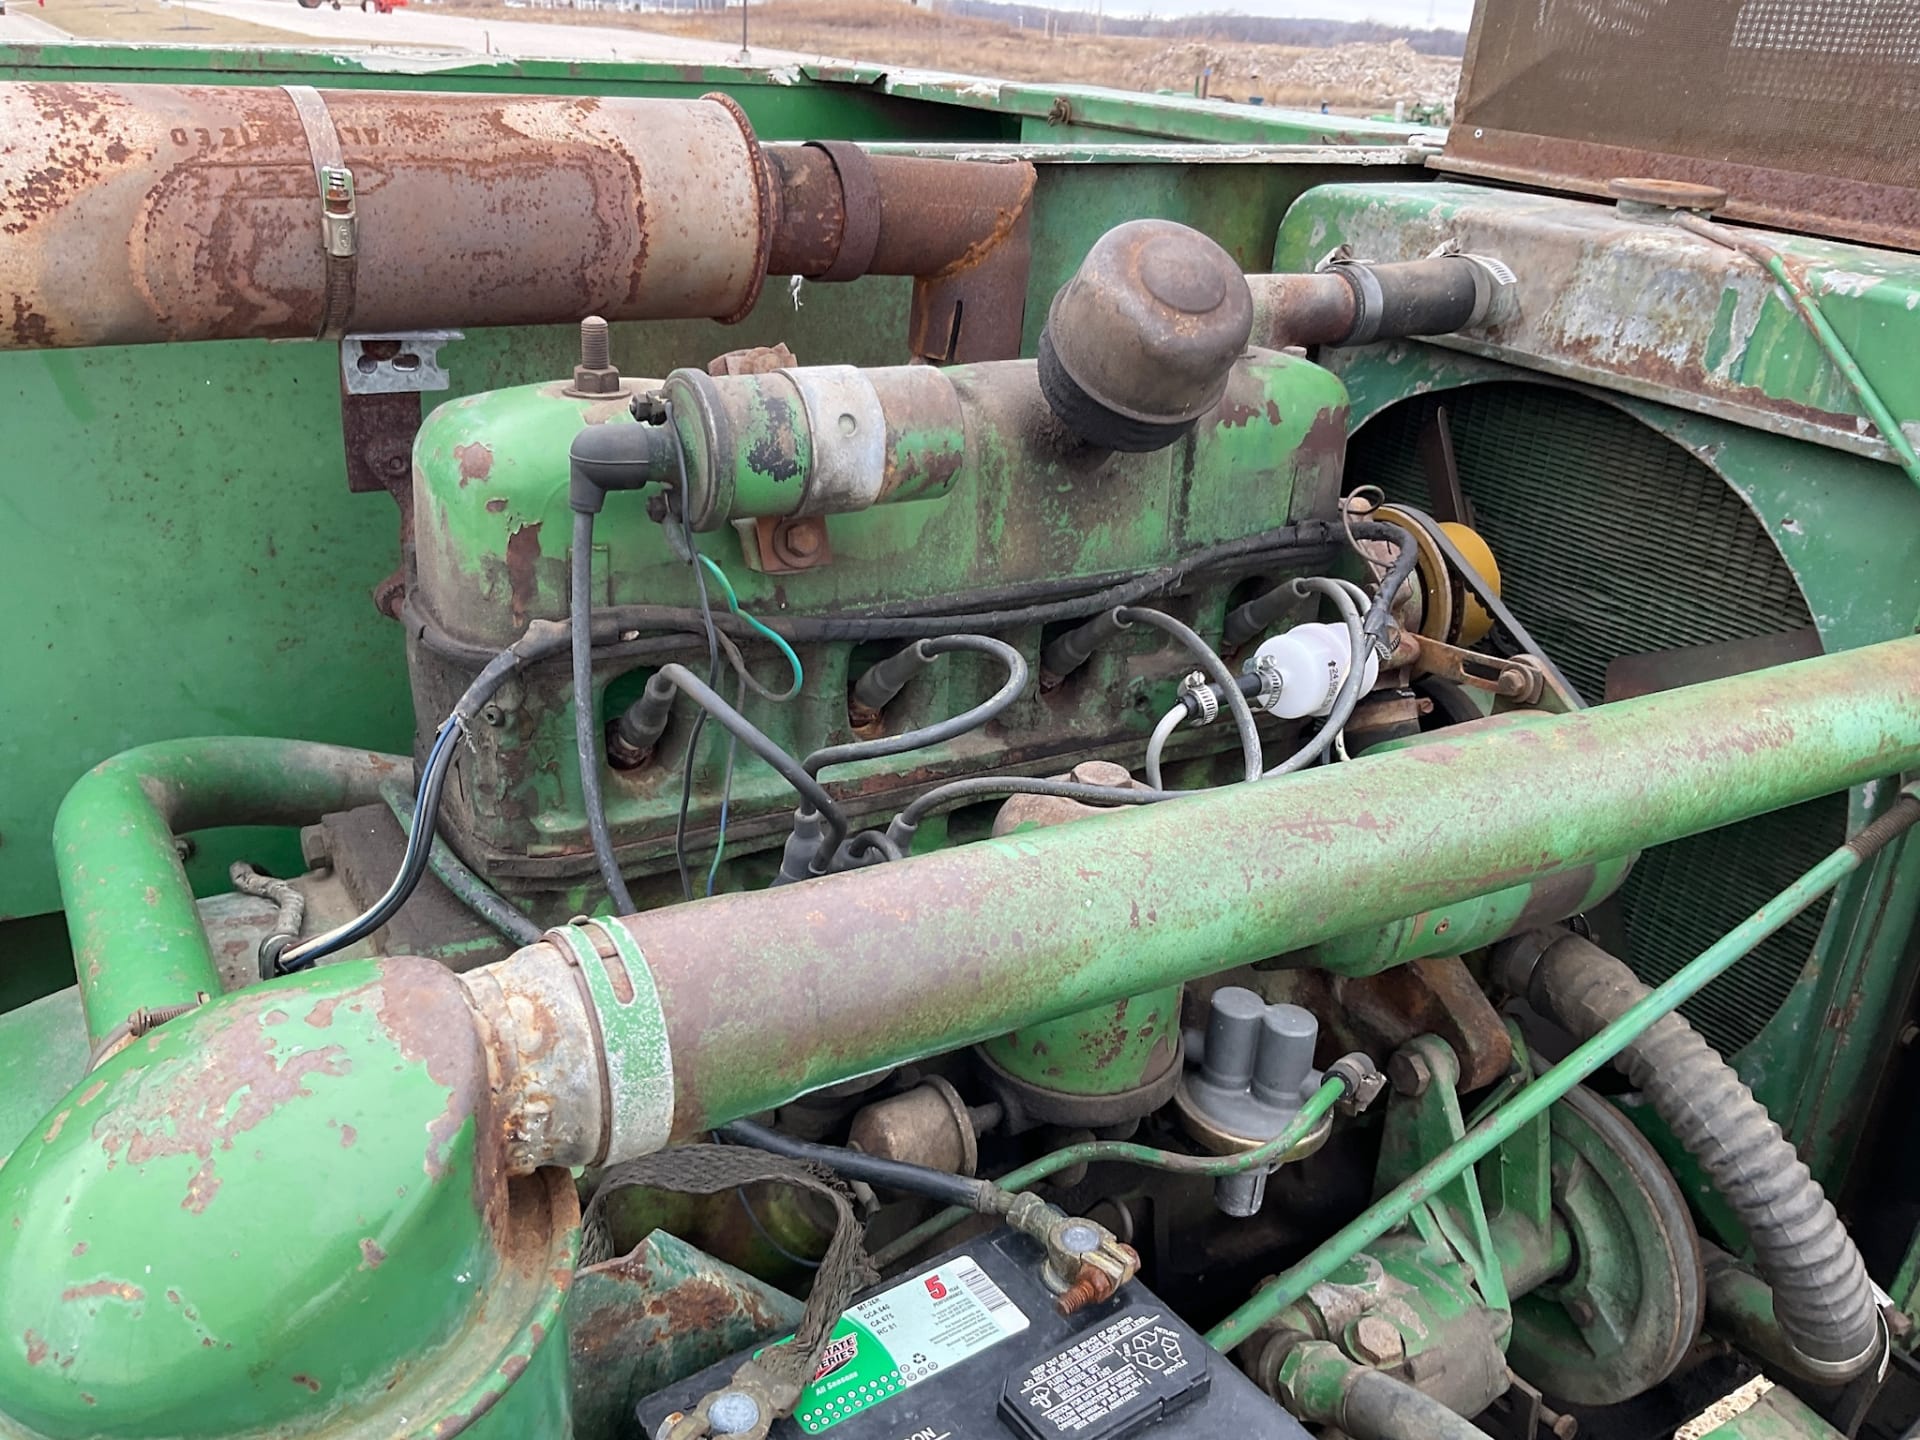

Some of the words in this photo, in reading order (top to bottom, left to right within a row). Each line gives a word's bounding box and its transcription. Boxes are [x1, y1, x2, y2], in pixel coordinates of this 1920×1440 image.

[924, 1275, 948, 1299] 5
[863, 1309, 879, 1319] CCA
[870, 1319, 882, 1327] CA
[877, 1327, 888, 1335] RC
[1023, 1379, 1034, 1387] DO
[1033, 1372, 1047, 1382] NOT
[1057, 1357, 1073, 1369] KEEP
[1073, 1349, 1088, 1360] VENT
[1087, 1341, 1104, 1352] CAPS
[1103, 1332, 1120, 1343] TIGHT
[1119, 1324, 1133, 1334] AND
[1030, 1365, 1046, 1376] KEEP
[1046, 1358, 1059, 1367] OUT
[1067, 1346, 1080, 1356] THE
[1079, 1335, 1099, 1349] REACH
[1106, 1316, 1133, 1334] CHILDREN
[1046, 1373, 1067, 1388] FLUSH
[1064, 1366, 1081, 1378] EYES
[1053, 1382, 1070, 1394] WITH
[1087, 1364, 1100, 1374] GET
[1163, 1359, 1188, 1375] RECYCLE
[815, 1385, 826, 1396] All
[826, 1371, 858, 1390] Seasons
[1059, 1383, 1085, 1400] MEDICAL
[1082, 1375, 1099, 1386] HELP
[1097, 1367, 1112, 1378] FAST
[1070, 1398, 1083, 1407] FOR
[1082, 1390, 1096, 1400] SAFE
[1095, 1383, 1109, 1393] JUMP
[1107, 1393, 1120, 1402] NOT
[1118, 1378, 1144, 1395] AVAILABLE
[1054, 1410, 1076, 1424] FOLLOW
[1075, 1390, 1111, 1412] INSTRUCTIONS
[1073, 1419, 1089, 1430] SEEK
[1087, 1407, 1109, 1422] SERVICE
